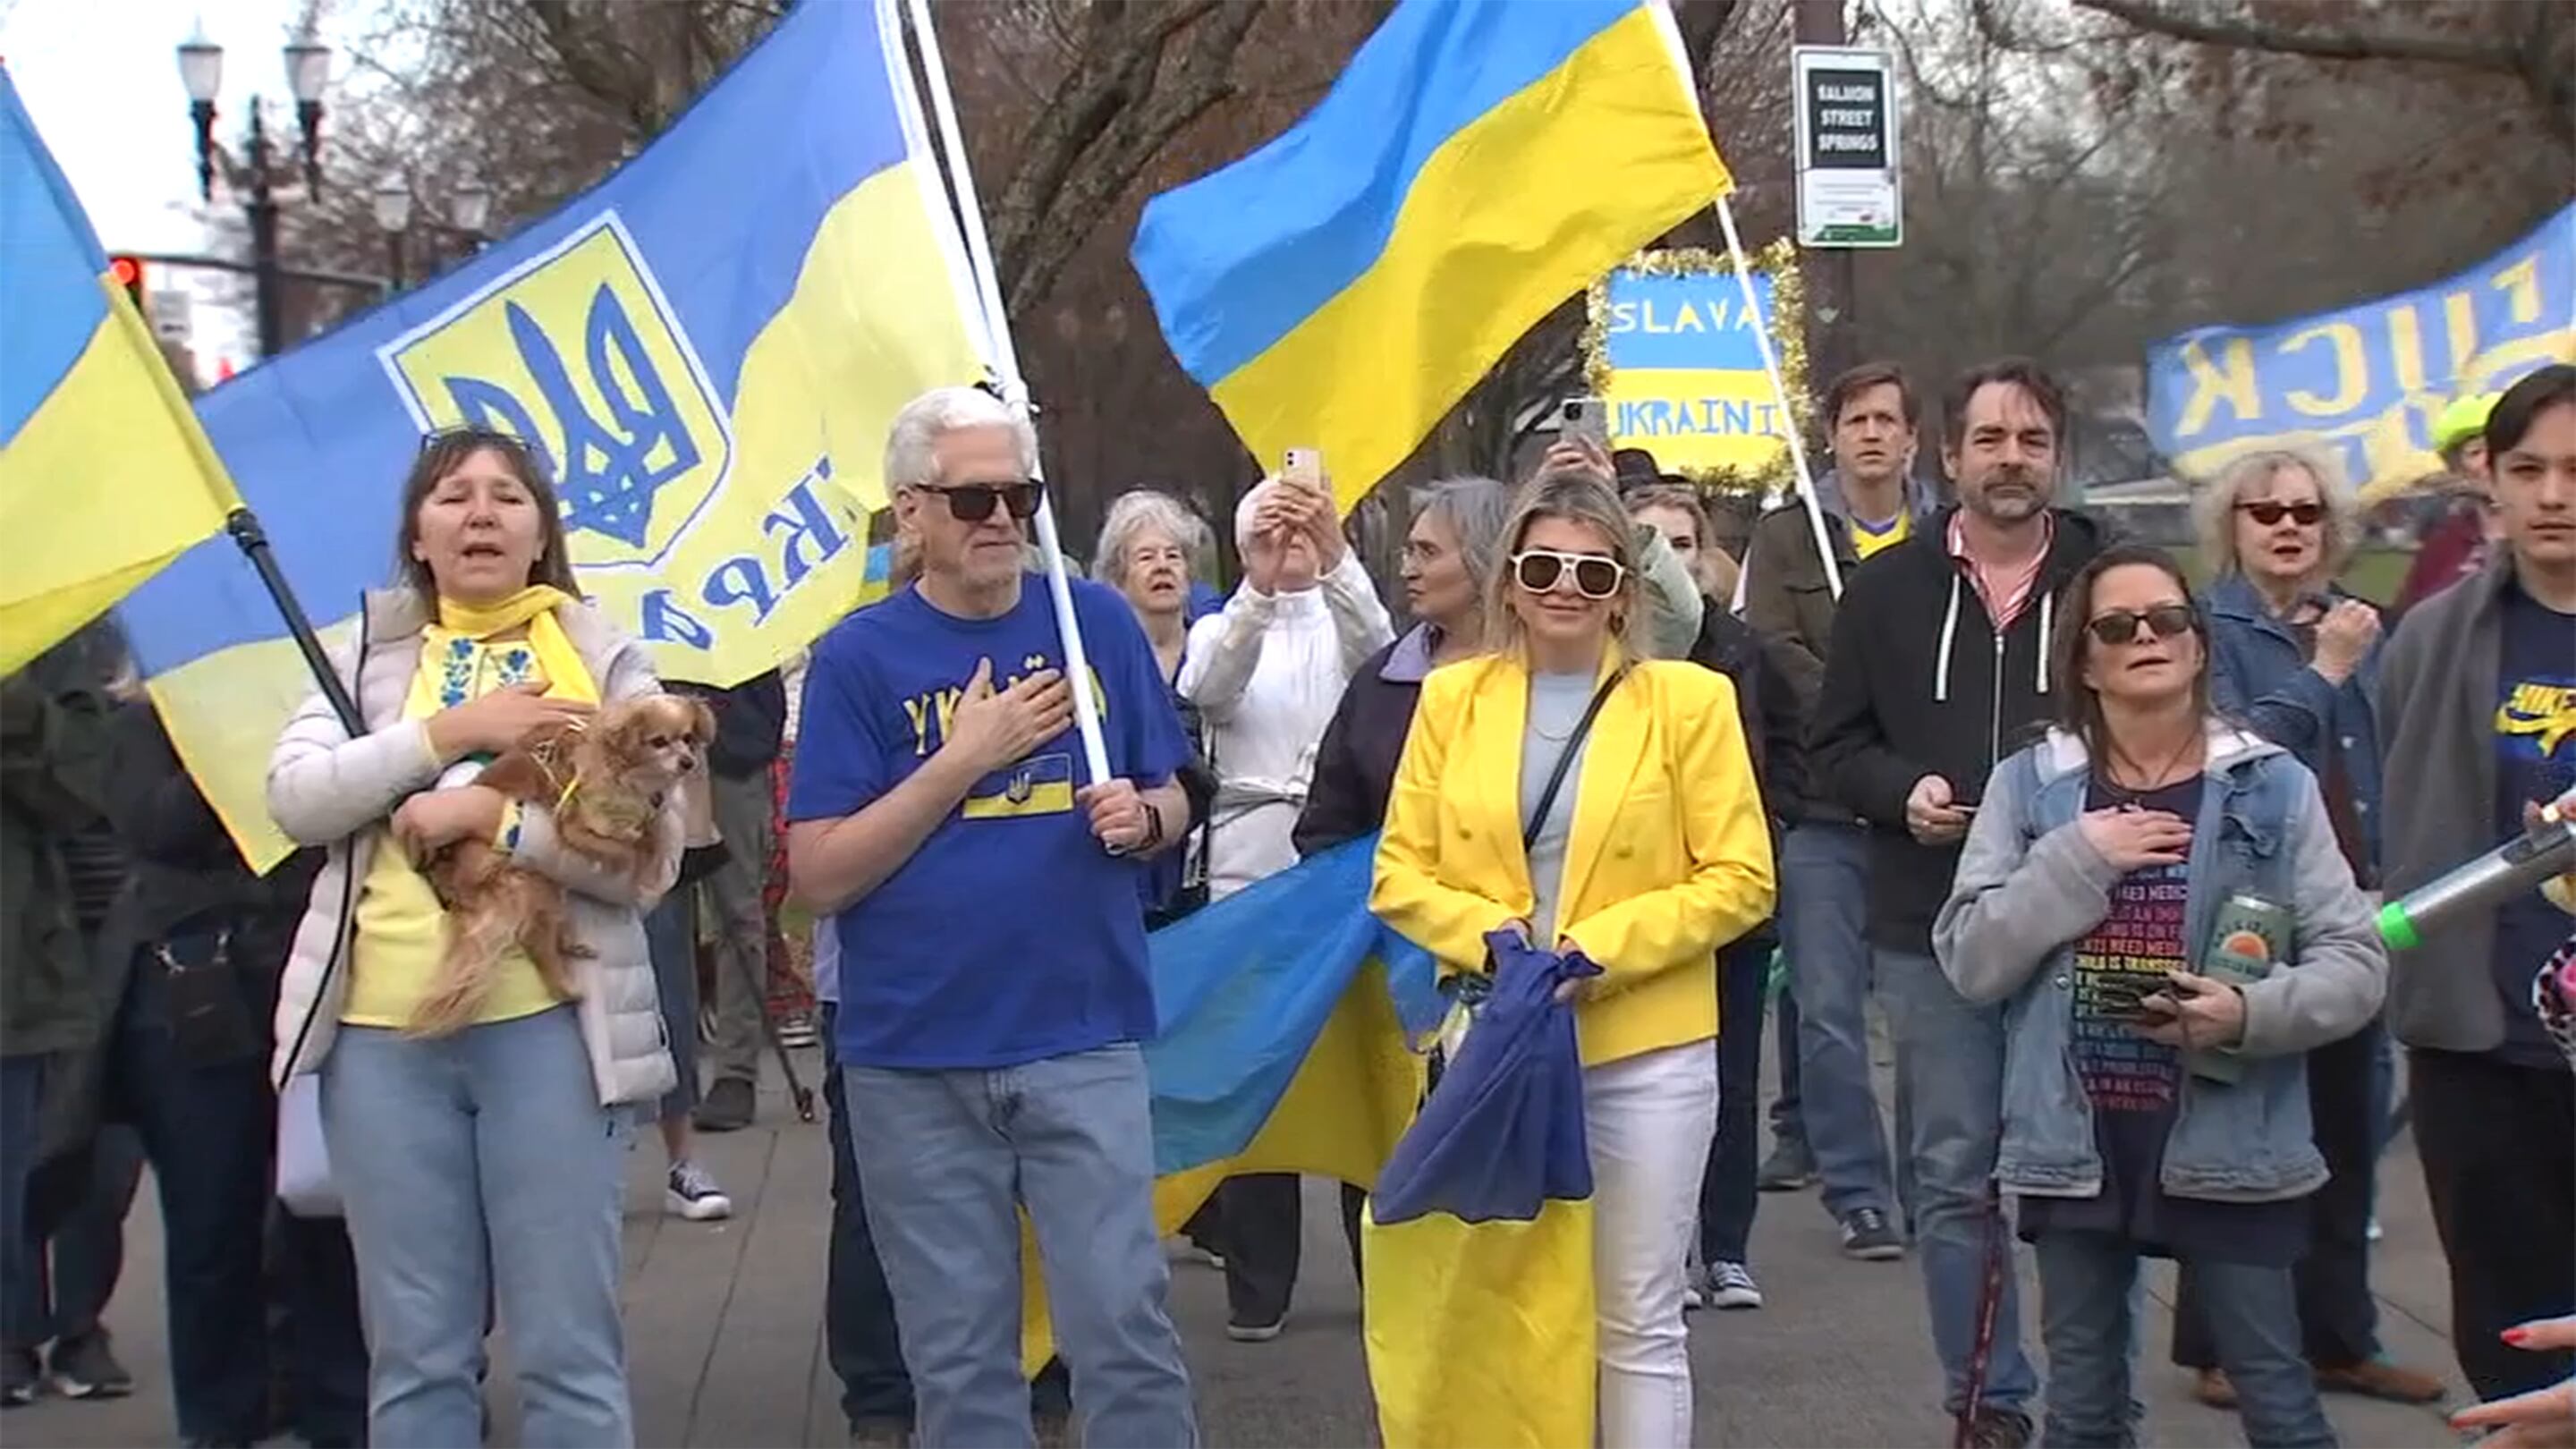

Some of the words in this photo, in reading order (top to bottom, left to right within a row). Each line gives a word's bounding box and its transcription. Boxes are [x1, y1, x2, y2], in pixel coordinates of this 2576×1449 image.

[1818, 84, 1876, 102] SALMON
[1820, 109, 1874, 127] STREET
[1818, 133, 1877, 151] SPRINGS
[1608, 298, 1758, 334] SLAVA
